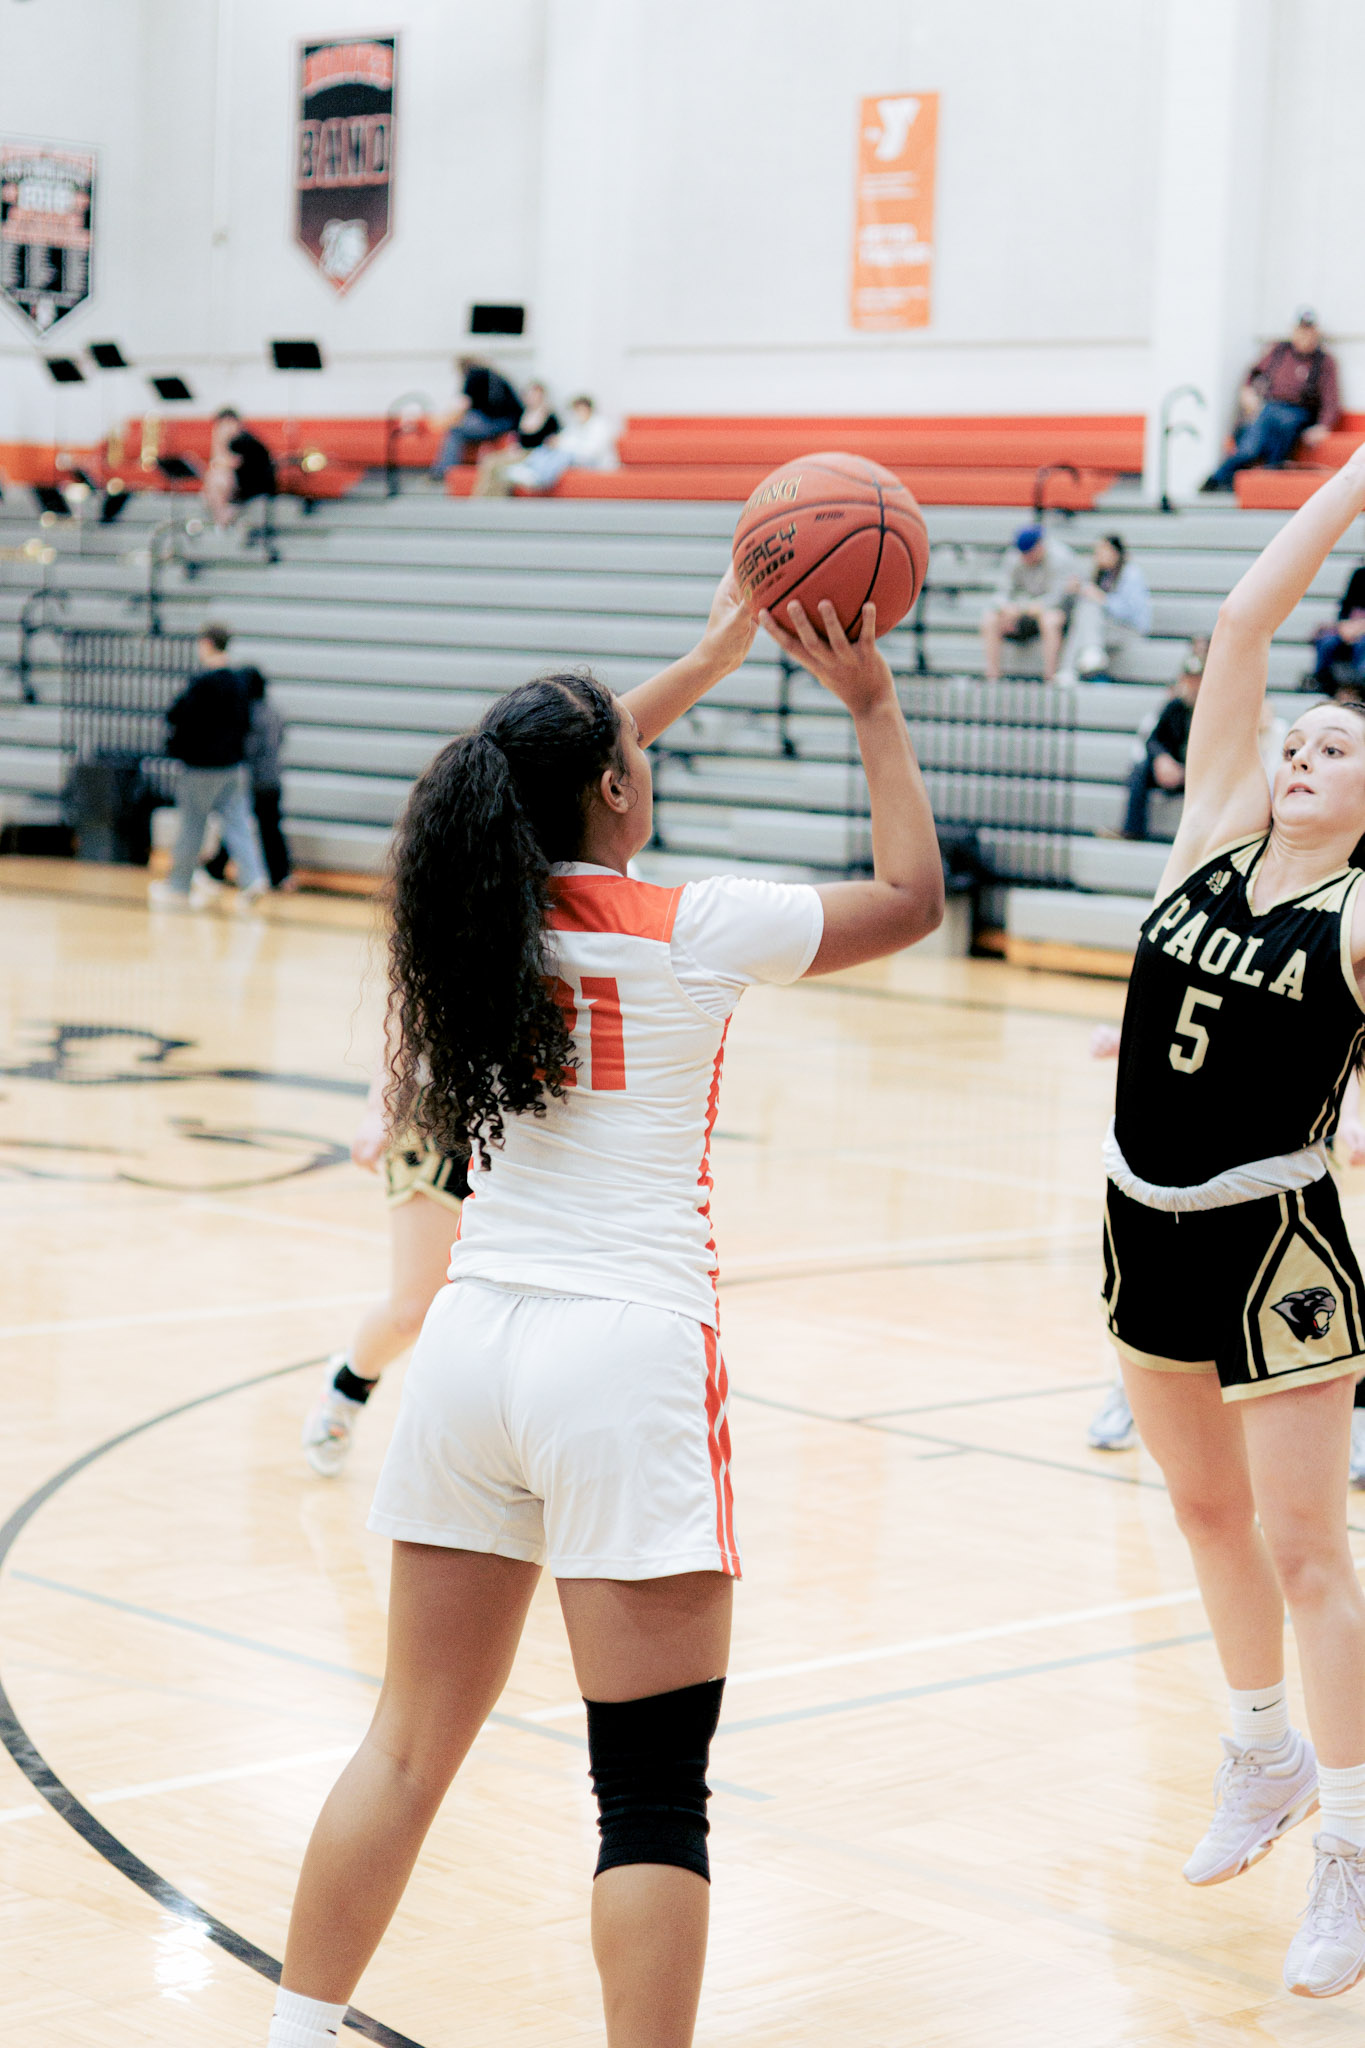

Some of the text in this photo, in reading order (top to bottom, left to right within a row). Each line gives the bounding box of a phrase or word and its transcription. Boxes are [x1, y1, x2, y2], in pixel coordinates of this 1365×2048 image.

[298, 114, 393, 188] BAND
[1147, 893, 1308, 1001] PAOLA
[1168, 985, 1224, 1075] 5
